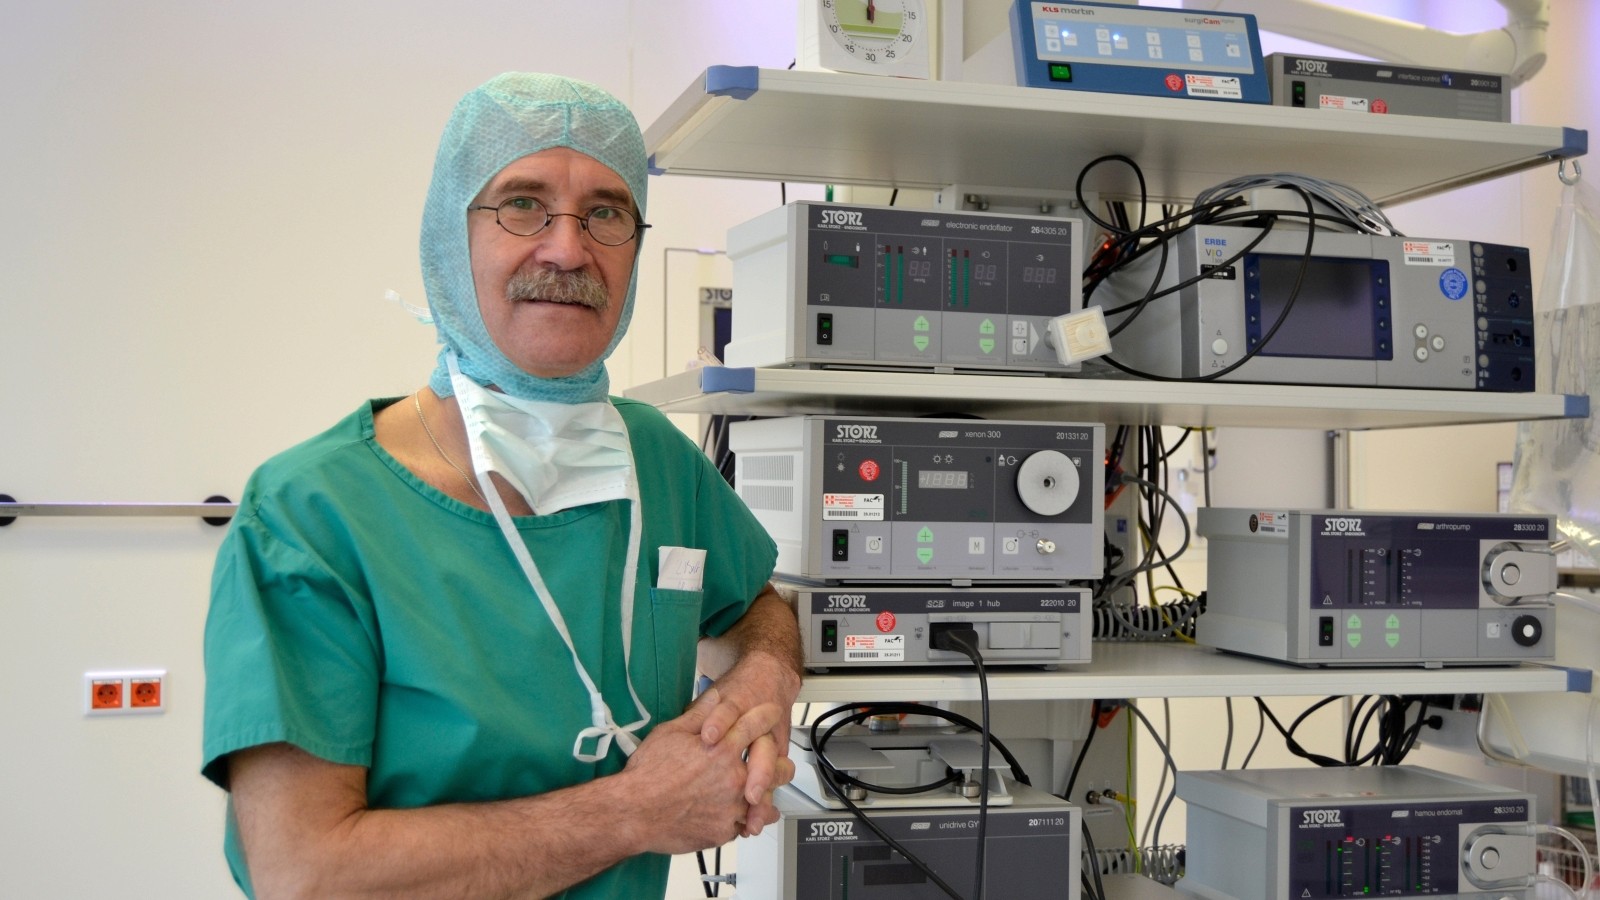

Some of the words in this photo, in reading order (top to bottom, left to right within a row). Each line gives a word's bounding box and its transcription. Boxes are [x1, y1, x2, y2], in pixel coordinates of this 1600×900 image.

[908, 11, 916, 20] 15
[1060, 8, 1094, 16] martin
[902, 34, 912, 42] 20
[866, 53, 876, 62] 30
[886, 50, 896, 58] 25
[1296, 59, 1328, 73] STORZ
[822, 210, 862, 226] STORZ
[946, 222, 978, 230] electronic
[980, 224, 1013, 232] endoflator
[837, 424, 878, 439] STORZ
[988, 430, 1001, 439] 300
[1325, 518, 1362, 532] STORZ
[828, 595, 866, 608] STORZ
[952, 600, 974, 608] image
[1303, 810, 1341, 824] STORZ
[811, 822, 854, 836] STORZ
[939, 821, 966, 829] unidrive
